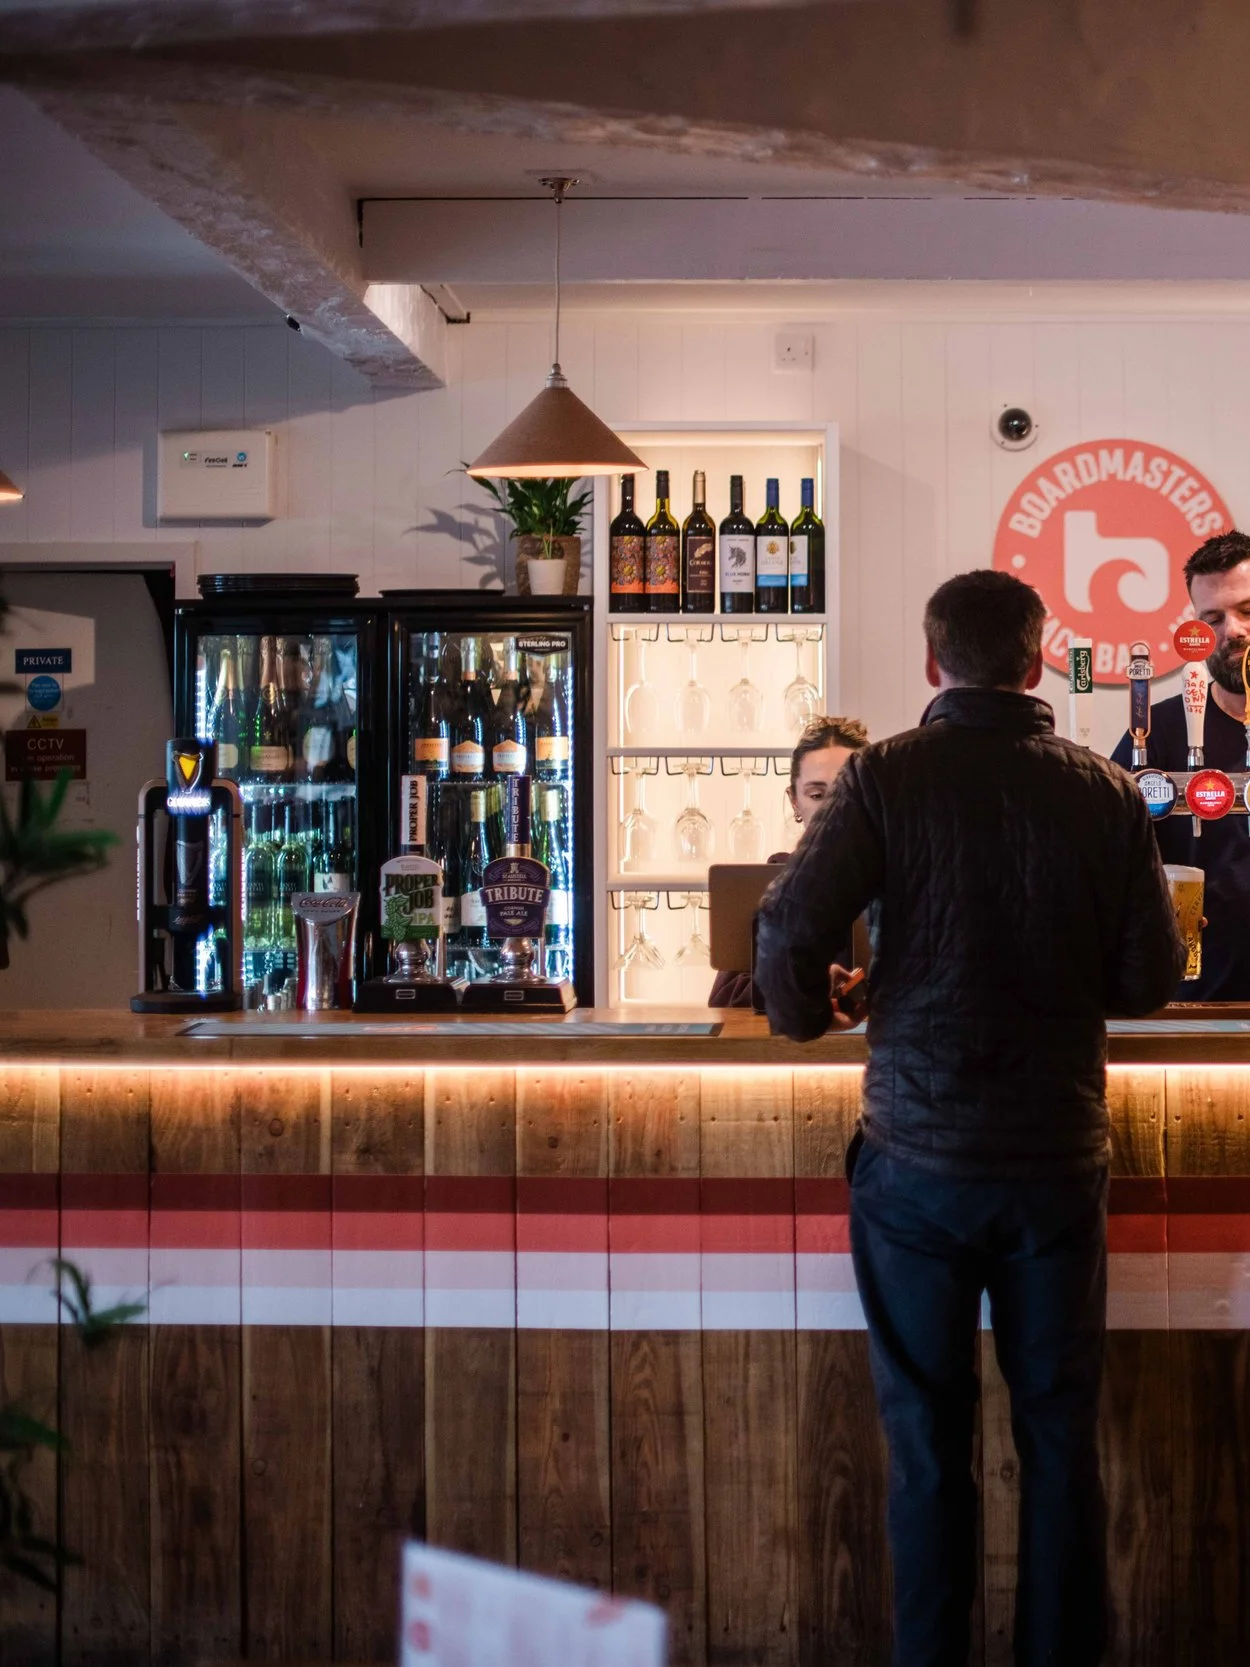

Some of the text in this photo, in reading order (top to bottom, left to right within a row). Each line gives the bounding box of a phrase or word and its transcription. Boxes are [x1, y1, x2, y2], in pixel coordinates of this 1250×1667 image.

[1008, 448, 1222, 538] BOARDMASTERS
[23, 656, 64, 666] PRIVATE
[1077, 650, 1091, 691] Carlsberg
[1129, 668, 1151, 677] PORETTI
[27, 738, 64, 750] CCTV
[37, 754, 75, 763] operation
[1141, 786, 1170, 798] ORETTI
[409, 780, 420, 842] PROPER JOB
[383, 874, 440, 896] PROPER
[485, 886, 544, 903] TRIBUTE
[299, 897, 347, 908] Coca-Cola
[403, 891, 434, 914] JOB
[411, 913, 435, 926] IPA
